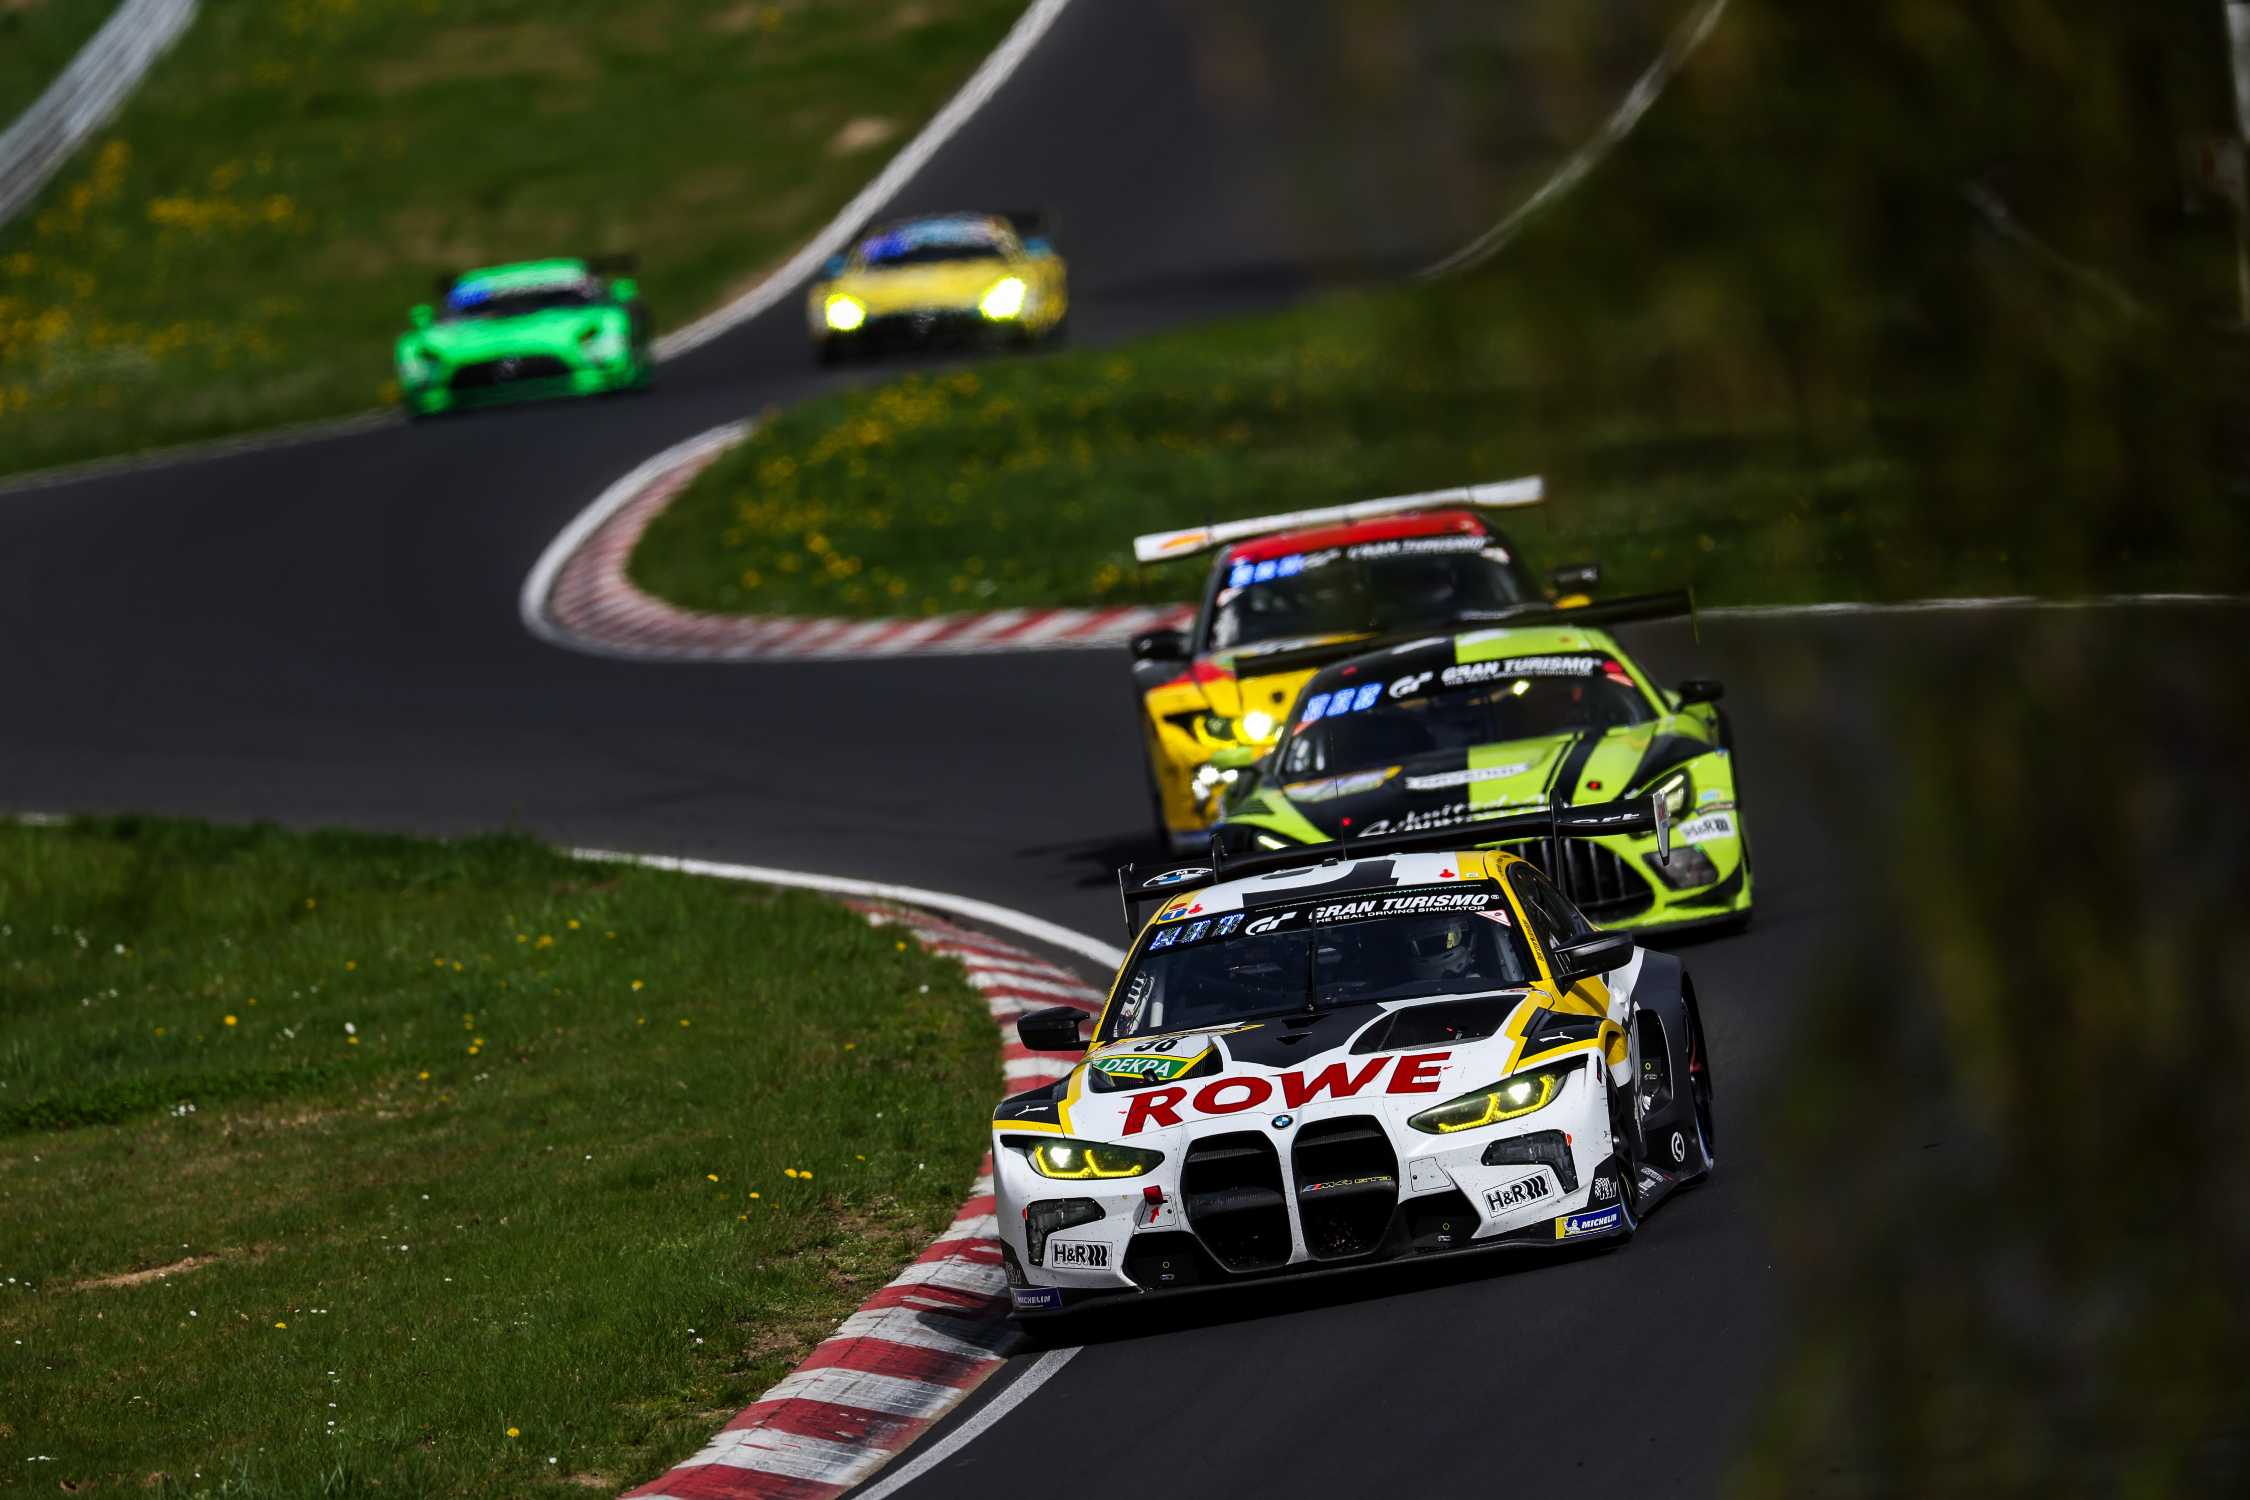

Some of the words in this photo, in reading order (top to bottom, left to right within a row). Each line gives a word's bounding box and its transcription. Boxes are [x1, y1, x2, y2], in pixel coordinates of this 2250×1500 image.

[1441, 661, 1498, 683] GRAN
[1308, 899, 1377, 921] GRAN
[1333, 912, 1364, 922] REAL
[1367, 908, 1416, 918] DRIVING
[1418, 904, 1485, 914] SIMULATOR
[1121, 1051, 1452, 1137] ROWE
[1486, 1184, 1527, 1211] H&R
[1581, 1213, 1617, 1229] MICHELIN
[1054, 1243, 1087, 1263] H&R
